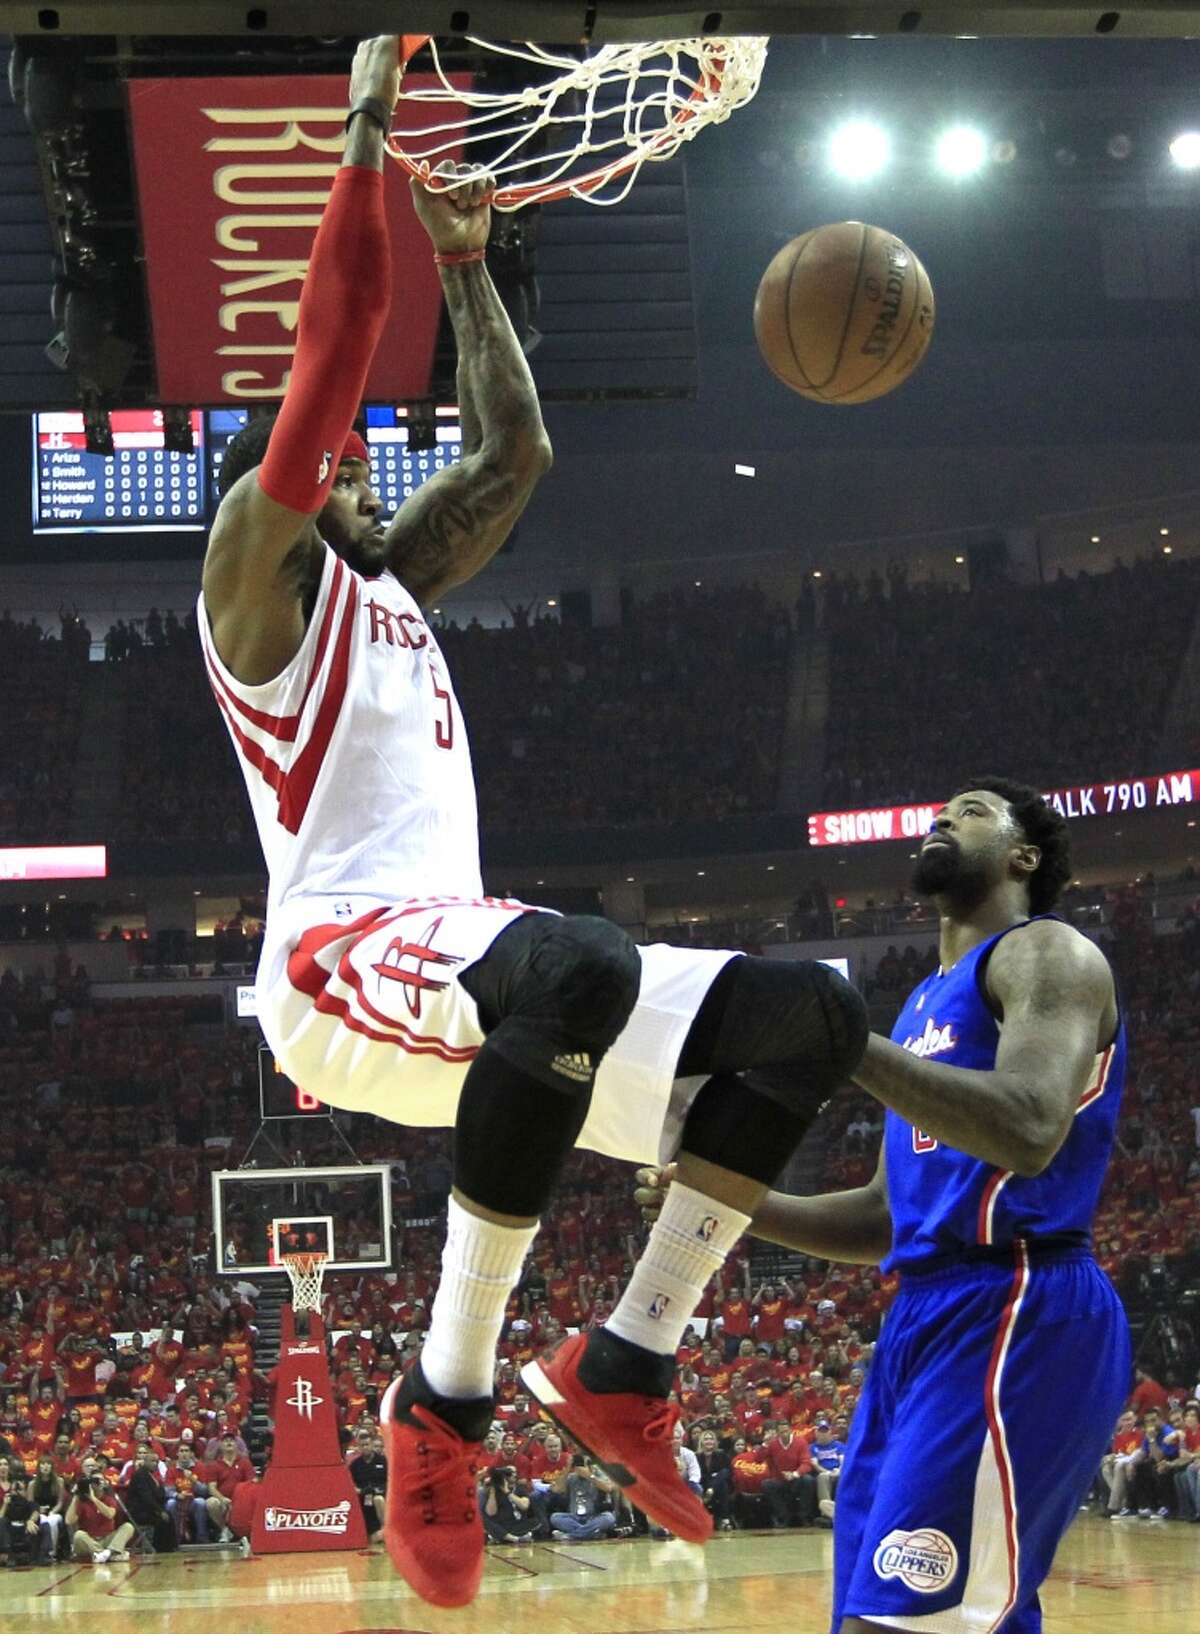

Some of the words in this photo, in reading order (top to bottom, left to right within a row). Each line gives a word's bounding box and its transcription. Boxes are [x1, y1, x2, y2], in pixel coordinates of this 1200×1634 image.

[121, 451, 131, 462] 0
[138, 451, 147, 462] 0
[154, 451, 163, 461] 0
[370, 446, 379, 457] 0
[386, 446, 395, 457] 0
[451, 445, 460, 456] 0
[105, 465, 114, 476] 0
[121, 464, 131, 475] 0
[138, 464, 147, 475] 0
[154, 464, 163, 475] 0
[171, 463, 180, 474] 0
[187, 463, 197, 474] 0
[386, 460, 396, 471] 0
[402, 460, 412, 471] 0
[419, 460, 428, 470] 0
[105, 478, 114, 489] 0
[121, 478, 131, 489] 0
[138, 478, 147, 488] 0
[154, 477, 164, 488] 0
[171, 477, 180, 488] 0
[188, 477, 197, 487] 0
[370, 473, 380, 484] 0
[387, 473, 396, 484] 0
[403, 473, 412, 484] 0
[105, 491, 115, 503] 0
[122, 491, 131, 502] 0
[140, 491, 146, 501] 1
[155, 491, 164, 501] 0
[171, 490, 181, 501] 0
[188, 490, 197, 501] 0
[388, 486, 397, 497] 0
[53, 508, 82, 519] Terry
[105, 506, 115, 517] 0
[122, 505, 131, 517] 0
[139, 505, 148, 516] 0
[155, 505, 164, 516] 0
[172, 504, 181, 515] 0
[188, 504, 198, 515] 0
[388, 500, 397, 511] 0
[429, 664, 453, 750] 5
[824, 810, 893, 843] SHOW
[901, 807, 933, 837] ON
[1103, 781, 1147, 813] 790
[1155, 773, 1193, 806] AM
[276, 1511, 349, 1528] PLAYOFFS
[879, 1543, 948, 1577] CLIPPERS
